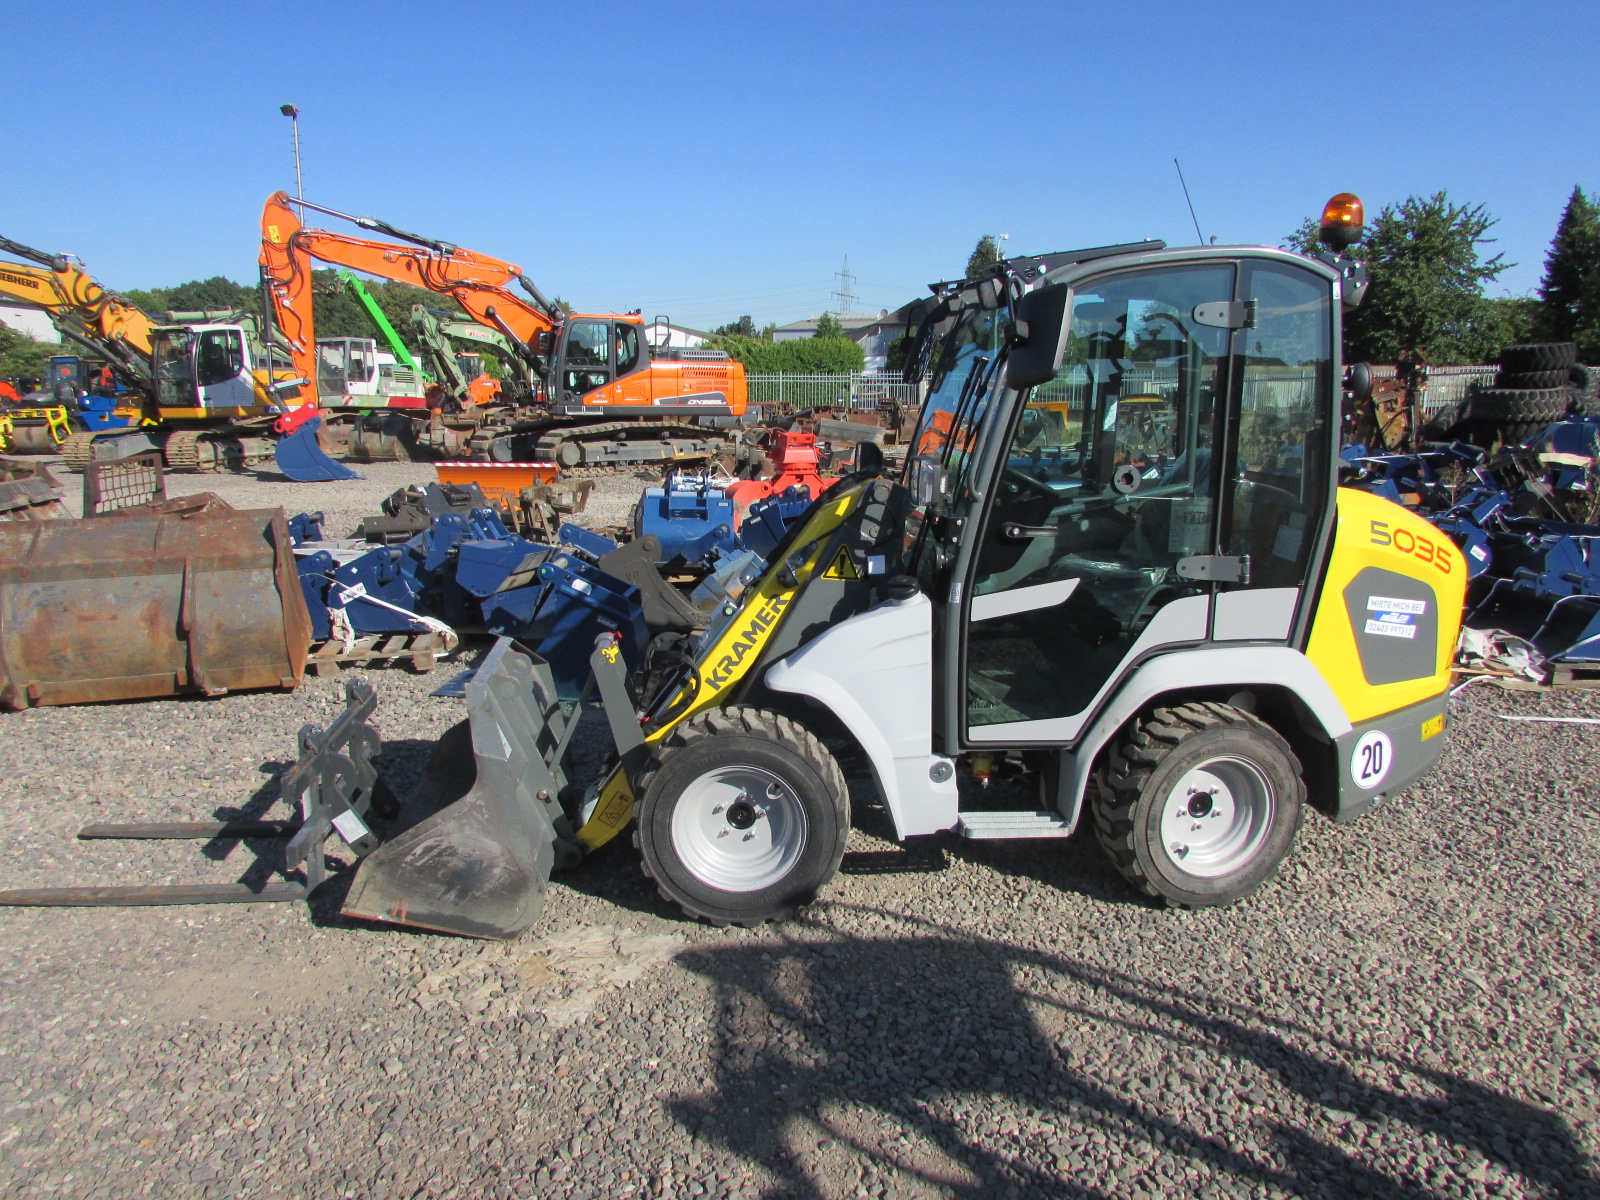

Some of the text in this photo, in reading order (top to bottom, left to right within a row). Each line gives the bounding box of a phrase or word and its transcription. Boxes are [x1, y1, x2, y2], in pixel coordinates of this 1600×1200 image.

[1370, 520, 1451, 574] 5035
[1370, 600, 1422, 612] MIETE MICH BEI
[705, 596, 790, 692] KRAMER
[1368, 622, 1388, 633] 02403
[1361, 740, 1383, 779] 20
